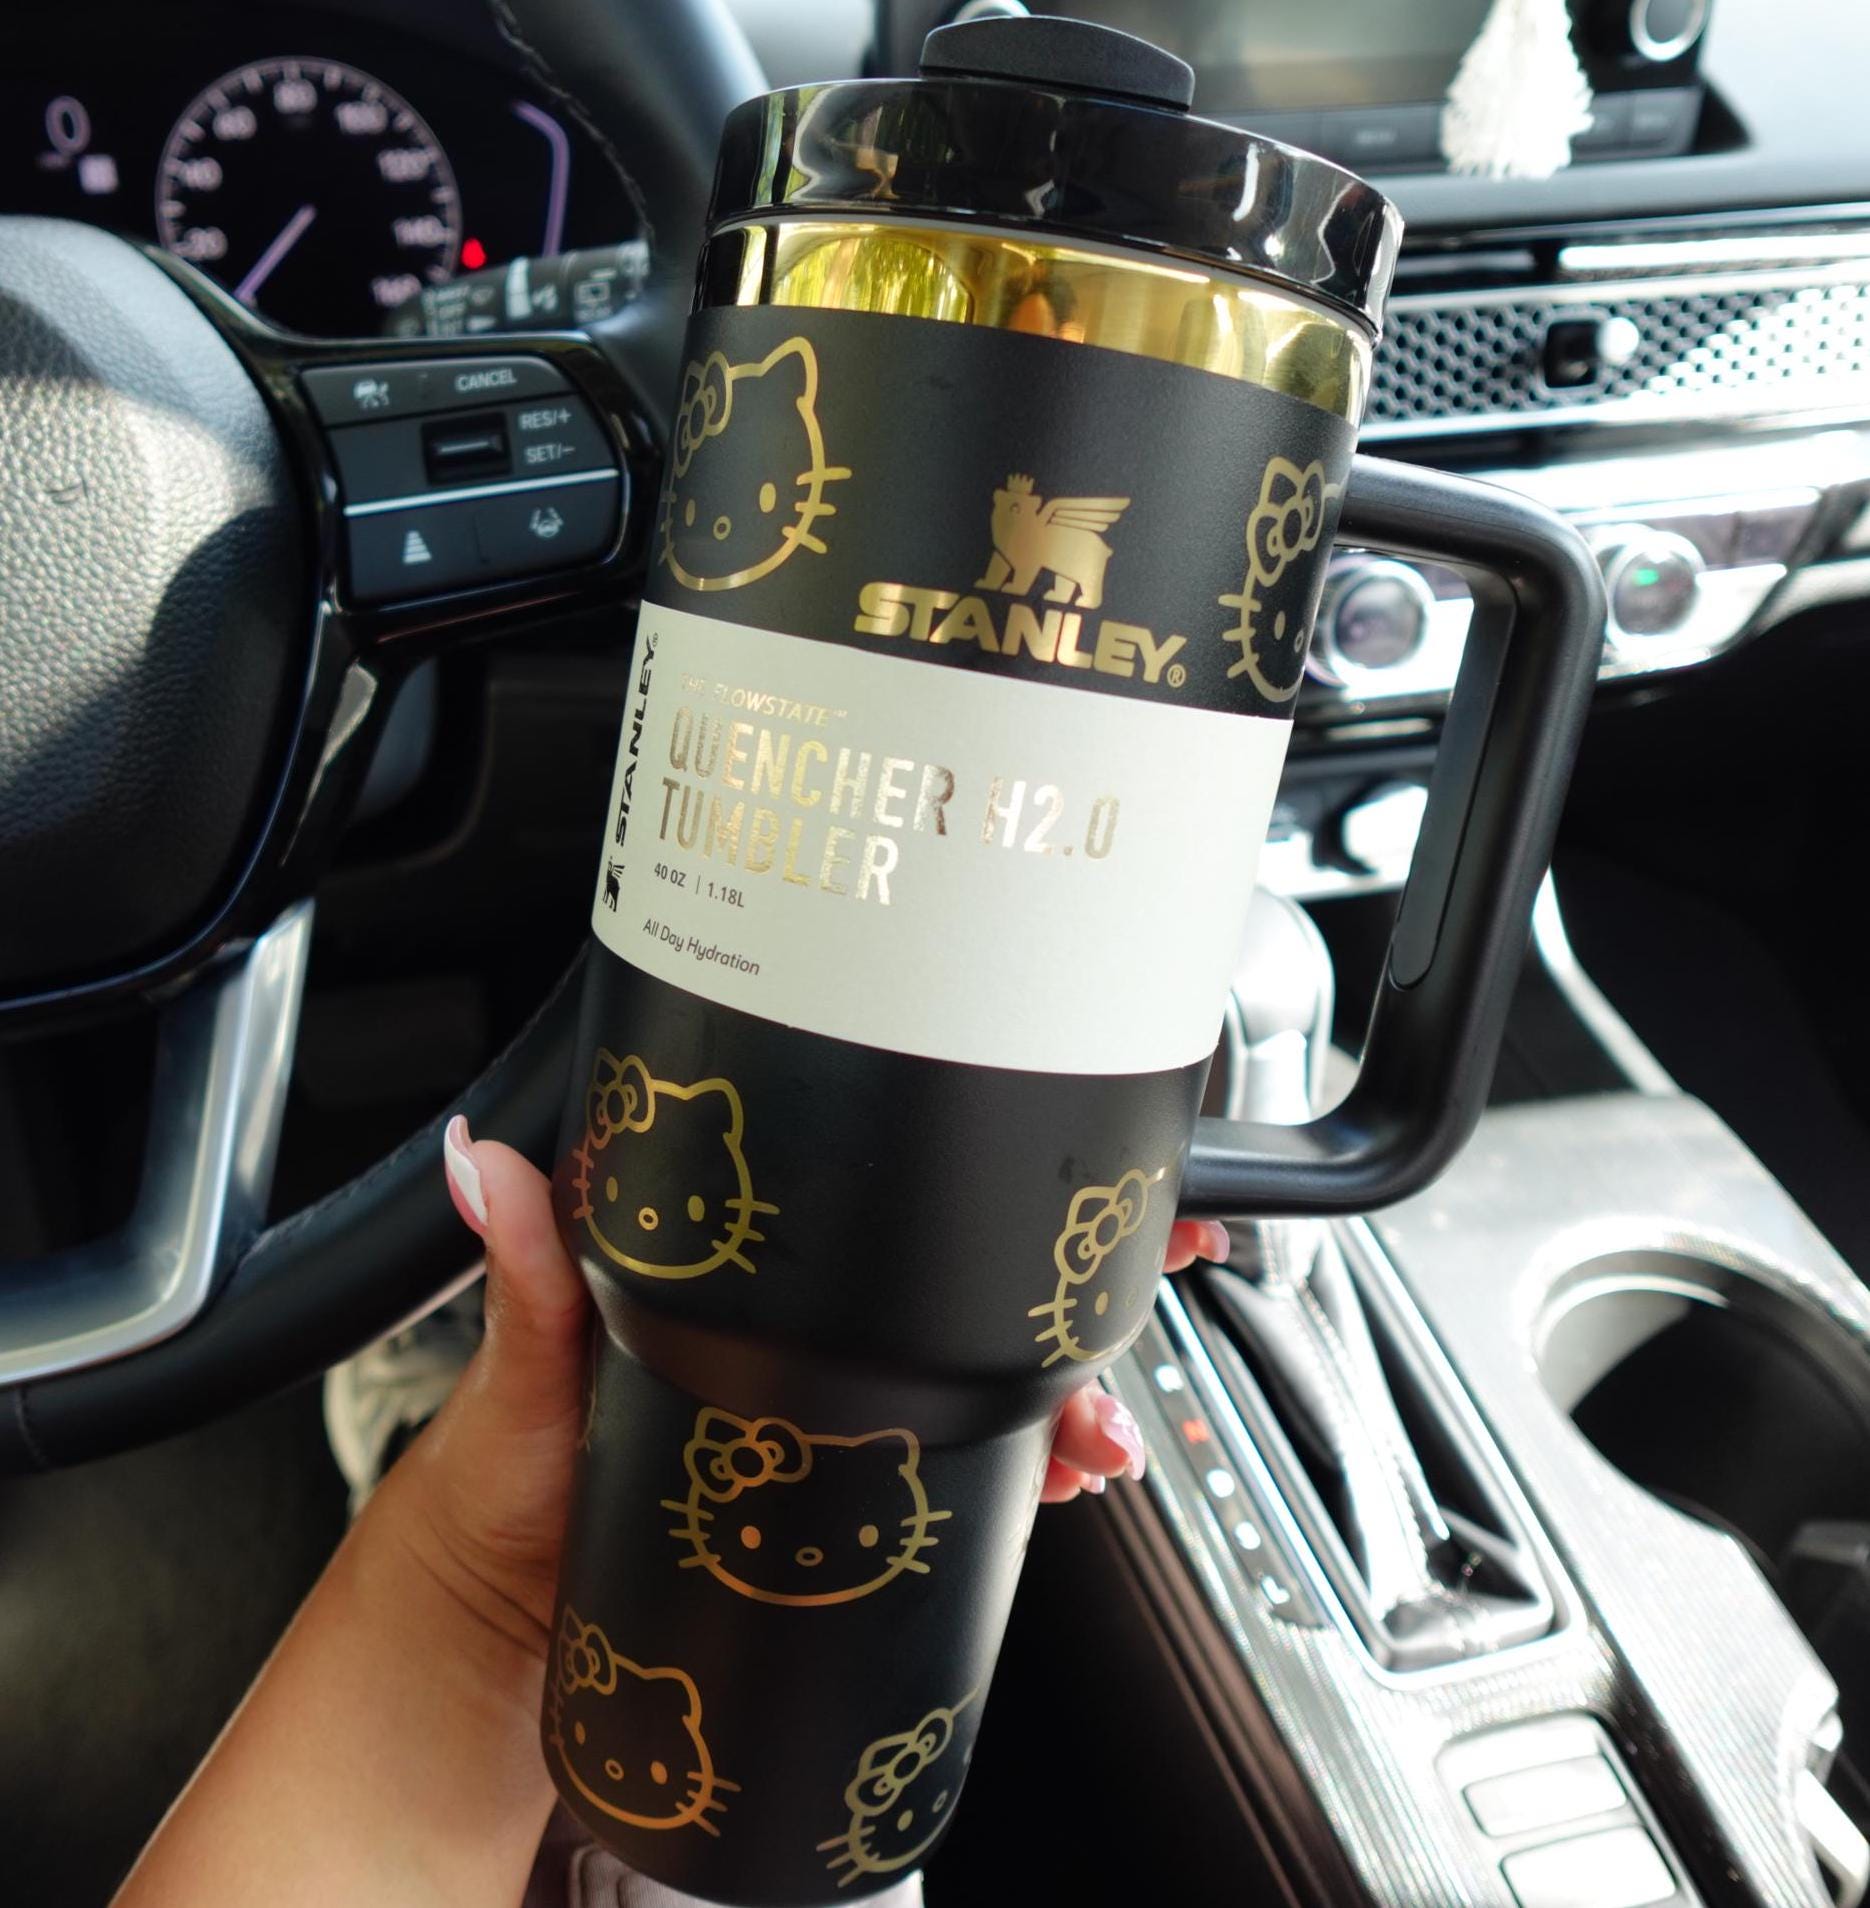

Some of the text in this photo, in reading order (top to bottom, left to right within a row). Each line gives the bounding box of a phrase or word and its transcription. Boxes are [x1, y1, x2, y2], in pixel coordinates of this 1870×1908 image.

[46, 95, 91, 155] 0
[455, 368, 518, 391] CANCEL
[518, 408, 571, 430] RES/+
[525, 443, 575, 463] SET/-
[670, 706, 1120, 859] QUENCHER H2.0
[659, 776, 899, 905] TUMBLER
[654, 862, 745, 908] 40 OZ 1.18L
[642, 918, 761, 976] All Day Hydration
